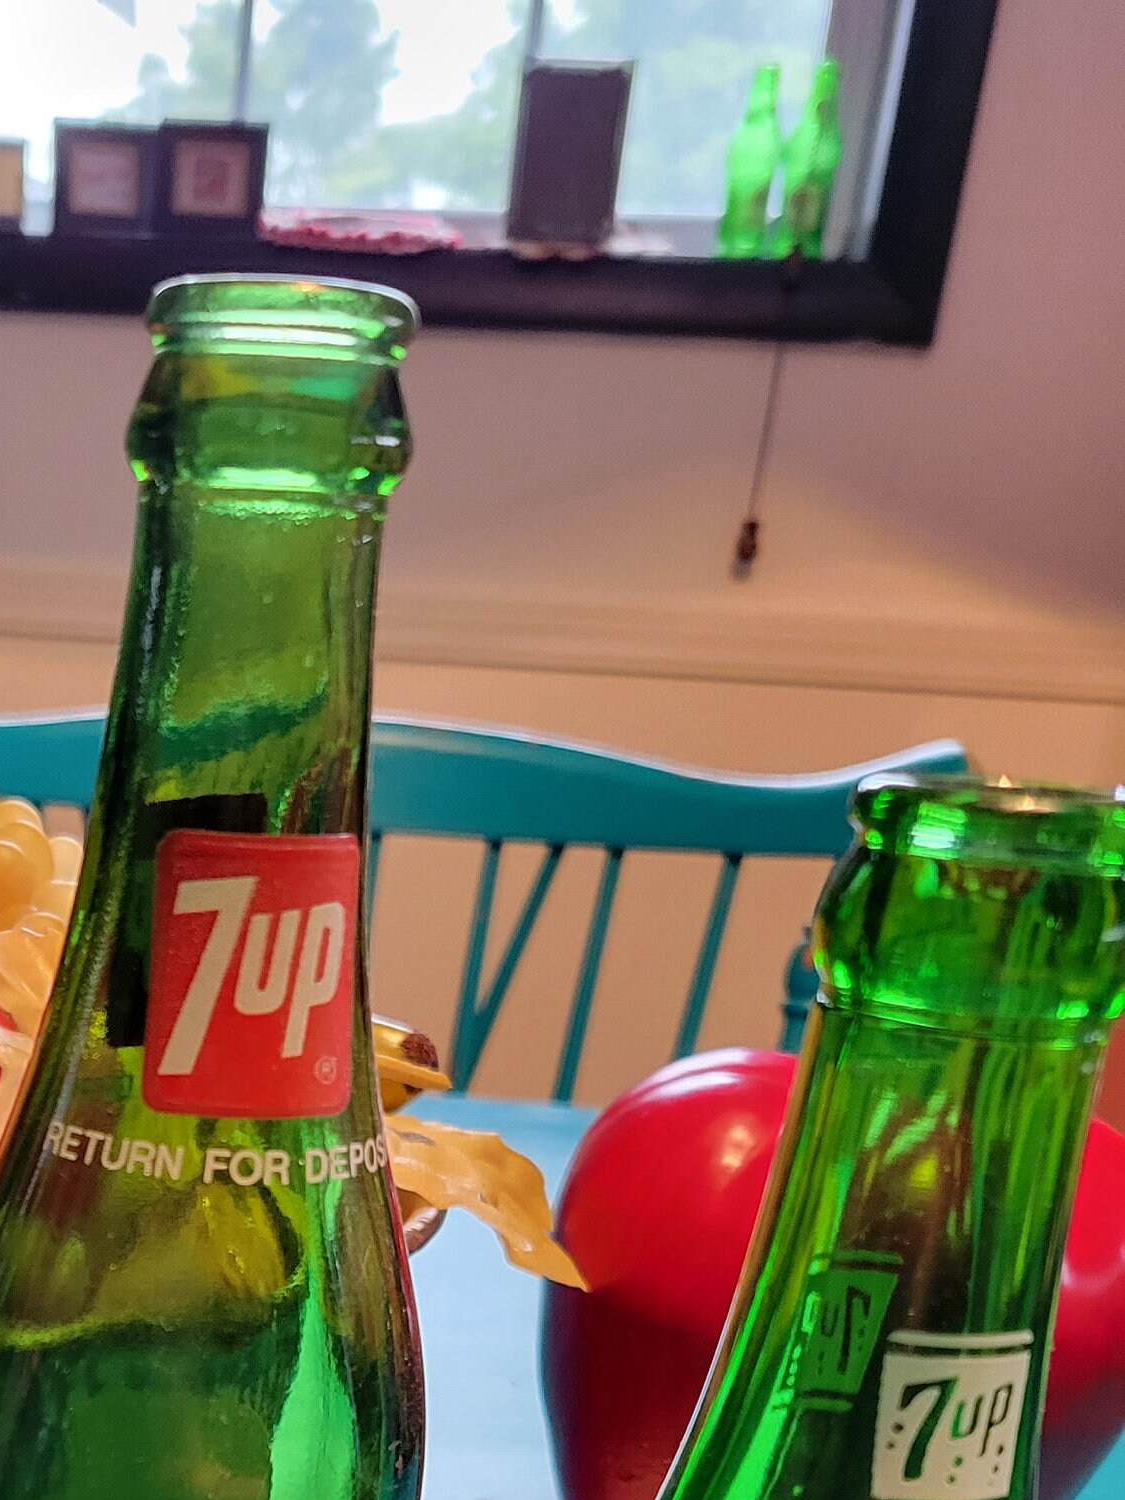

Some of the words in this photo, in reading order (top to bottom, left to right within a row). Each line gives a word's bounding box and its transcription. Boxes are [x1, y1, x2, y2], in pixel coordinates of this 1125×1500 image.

[43, 1119, 184, 1180] RETURN
[203, 1147, 290, 1185] FOR
[305, 1134, 386, 1185] DEPOS
